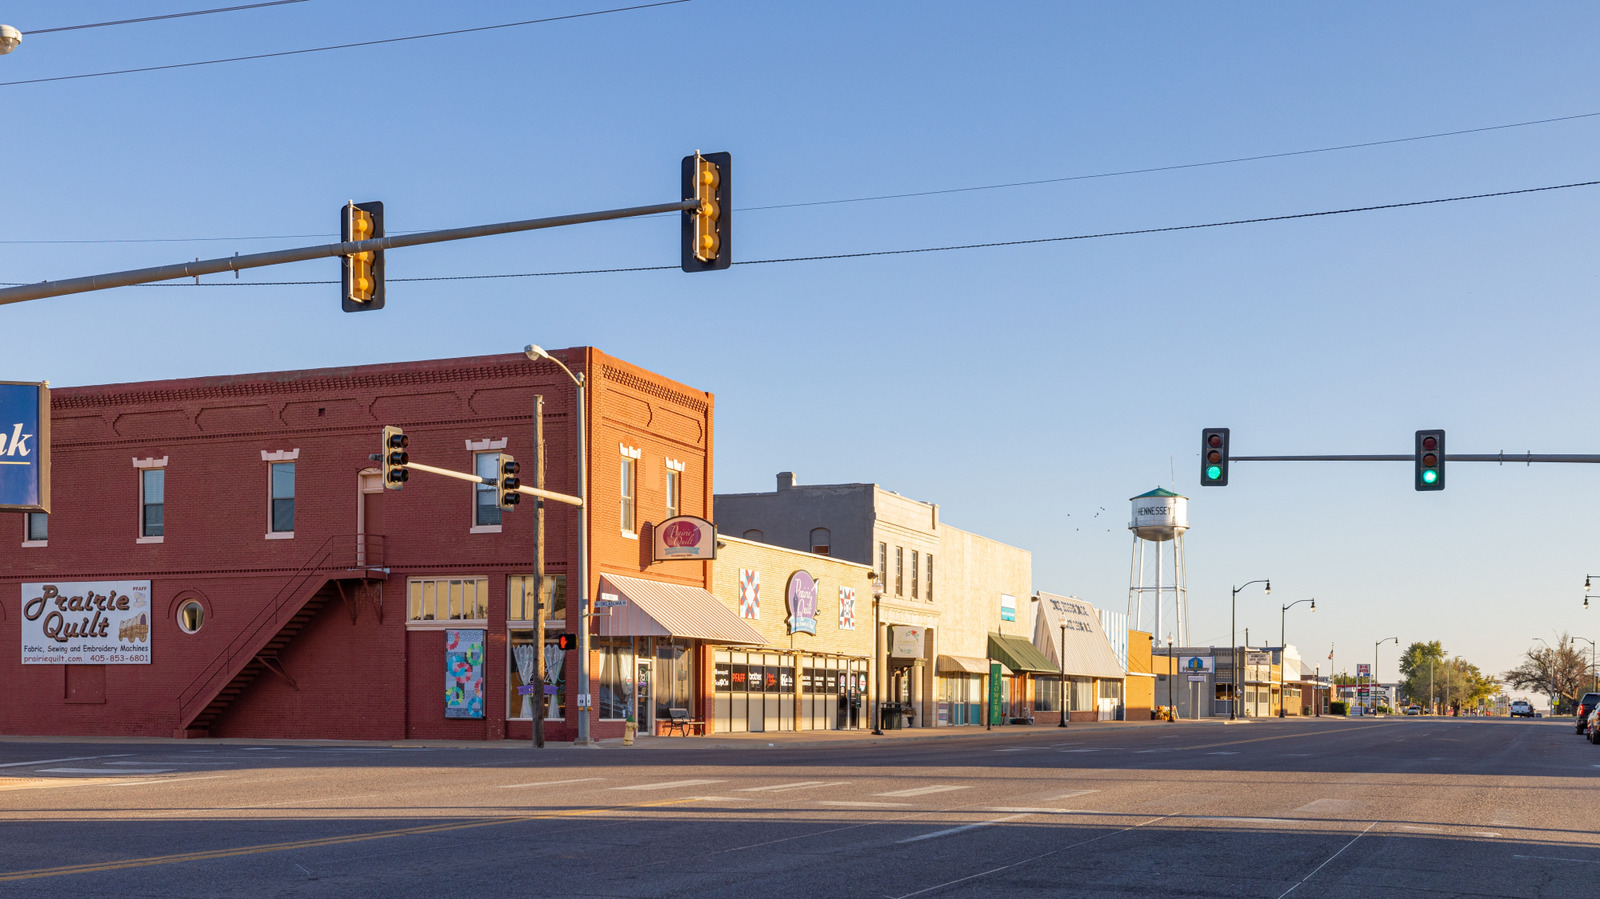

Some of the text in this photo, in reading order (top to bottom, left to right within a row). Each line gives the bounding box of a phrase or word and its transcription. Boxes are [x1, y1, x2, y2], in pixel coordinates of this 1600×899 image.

[1138, 506, 1171, 516] HENNESSEY
[670, 525, 691, 538] Prairie
[673, 533, 695, 548] Quilt
[24, 584, 130, 621] Prairie
[42, 610, 109, 642] Quilt
[24, 645, 45, 653] Fabric,
[47, 645, 67, 654] Sewing
[83, 645, 118, 653] Embroidery
[23, 654, 148, 663] prairiequilt.com 405-853-6801
[732, 673, 746, 682] PFAFF
